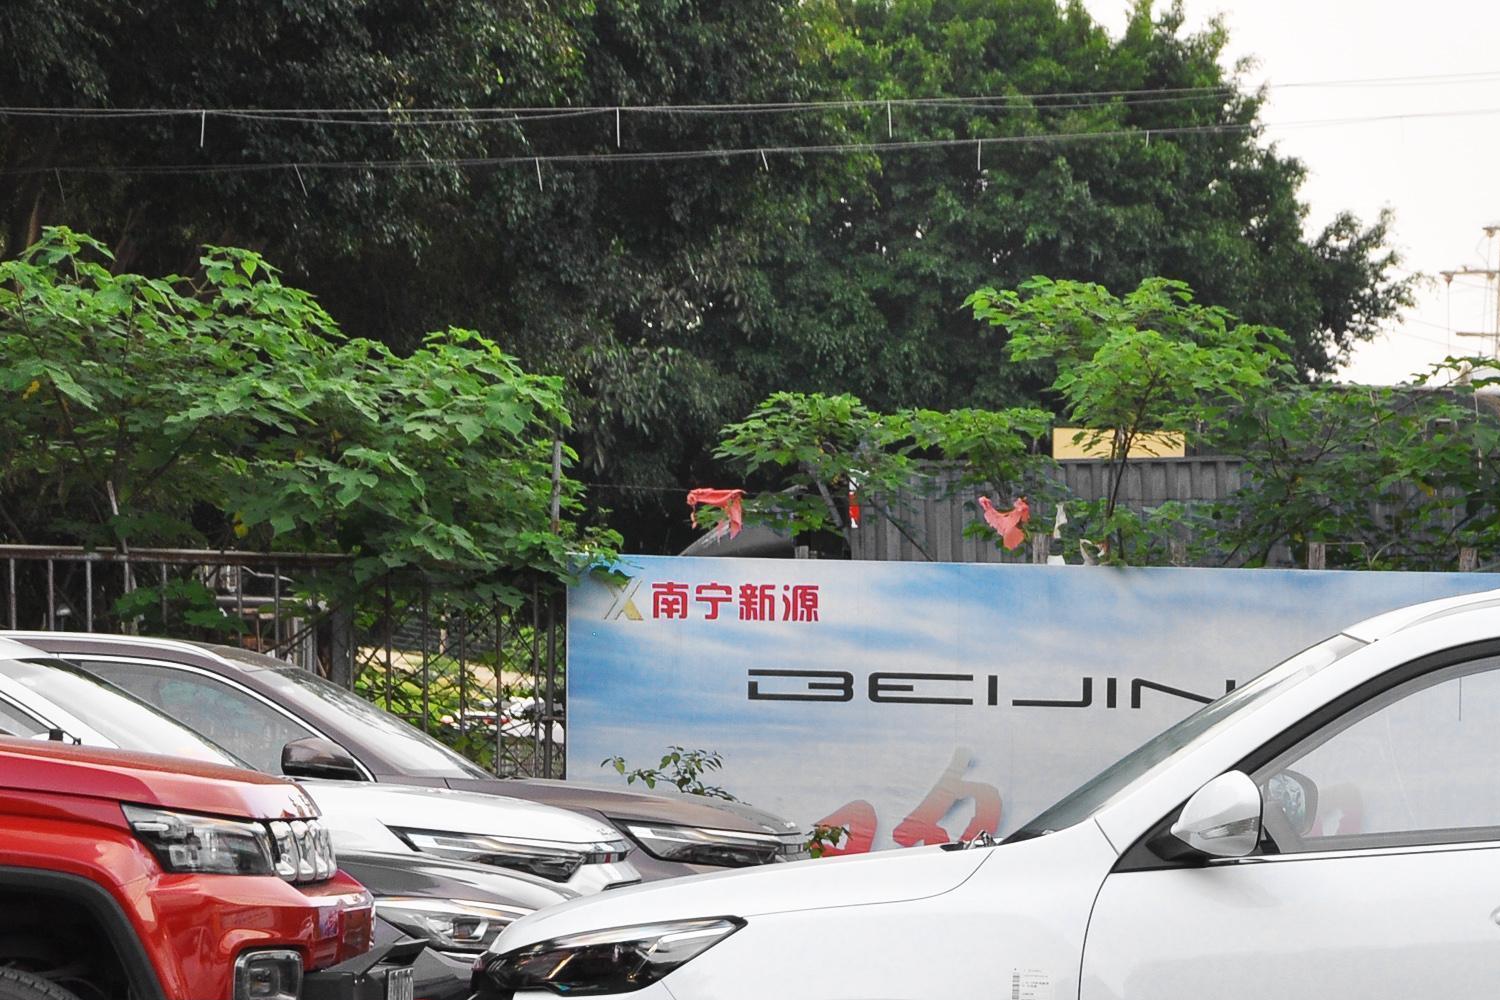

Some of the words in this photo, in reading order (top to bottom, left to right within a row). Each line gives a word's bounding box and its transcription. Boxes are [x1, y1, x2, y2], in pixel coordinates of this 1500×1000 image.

[652, 581, 819, 622] 南宁新源
[748, 668, 1236, 709] BEIJIN
